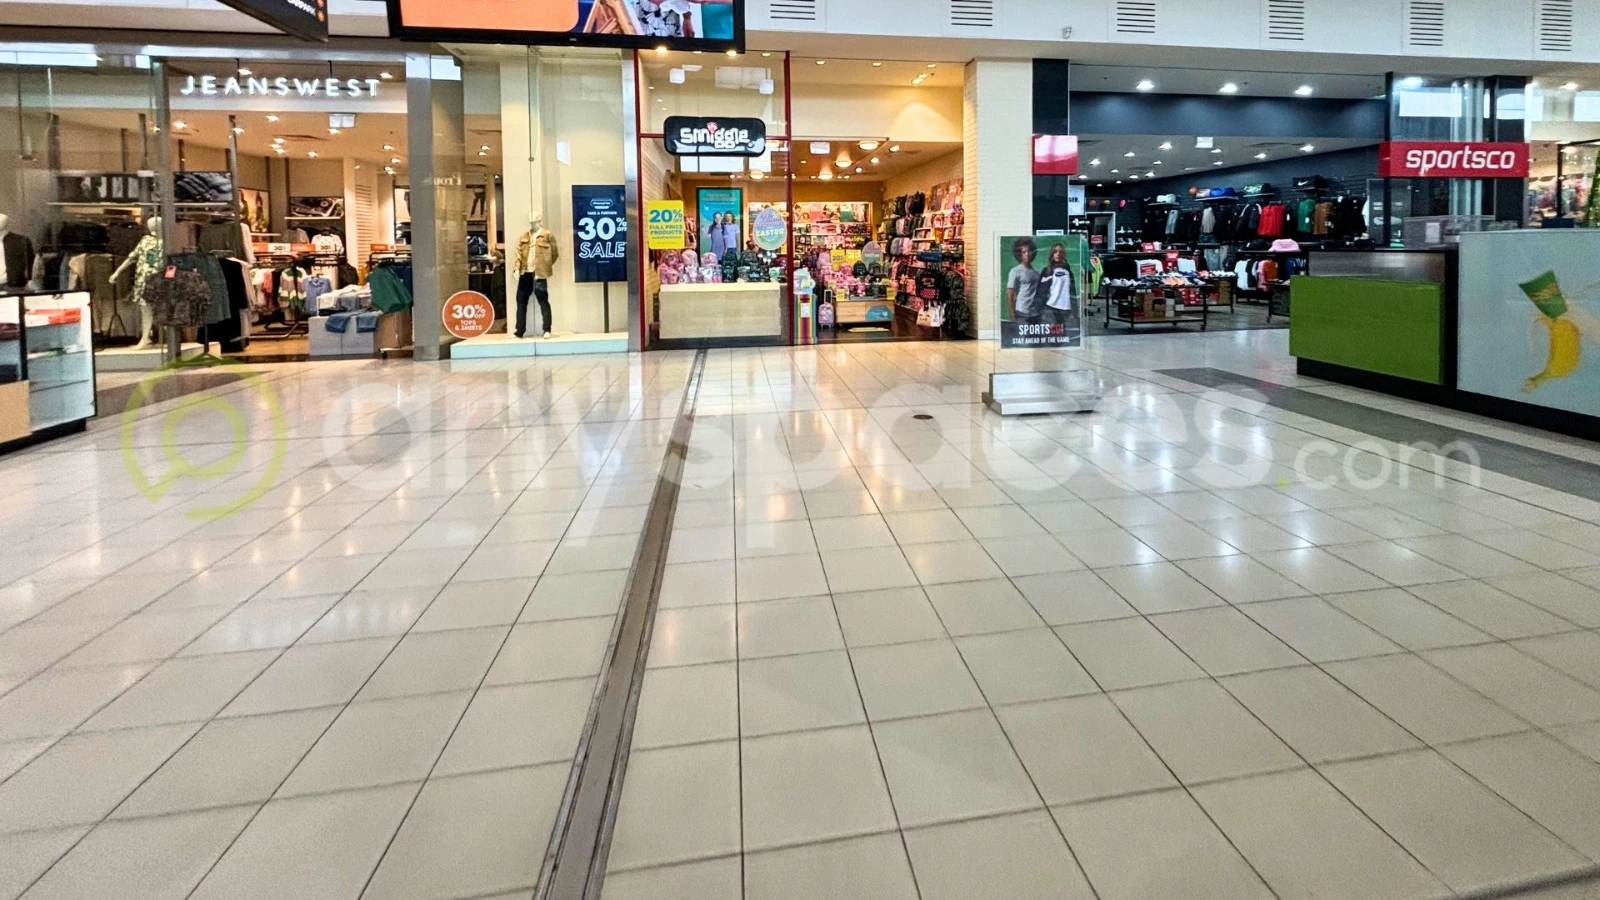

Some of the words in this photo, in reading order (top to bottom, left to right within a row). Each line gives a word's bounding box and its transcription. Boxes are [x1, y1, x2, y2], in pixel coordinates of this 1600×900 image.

[181, 76, 380, 97] JEANSWEST
[1405, 145, 1515, 176] sportsco
[649, 209, 683, 223] 20%
[1012, 337, 1025, 345] STAY
